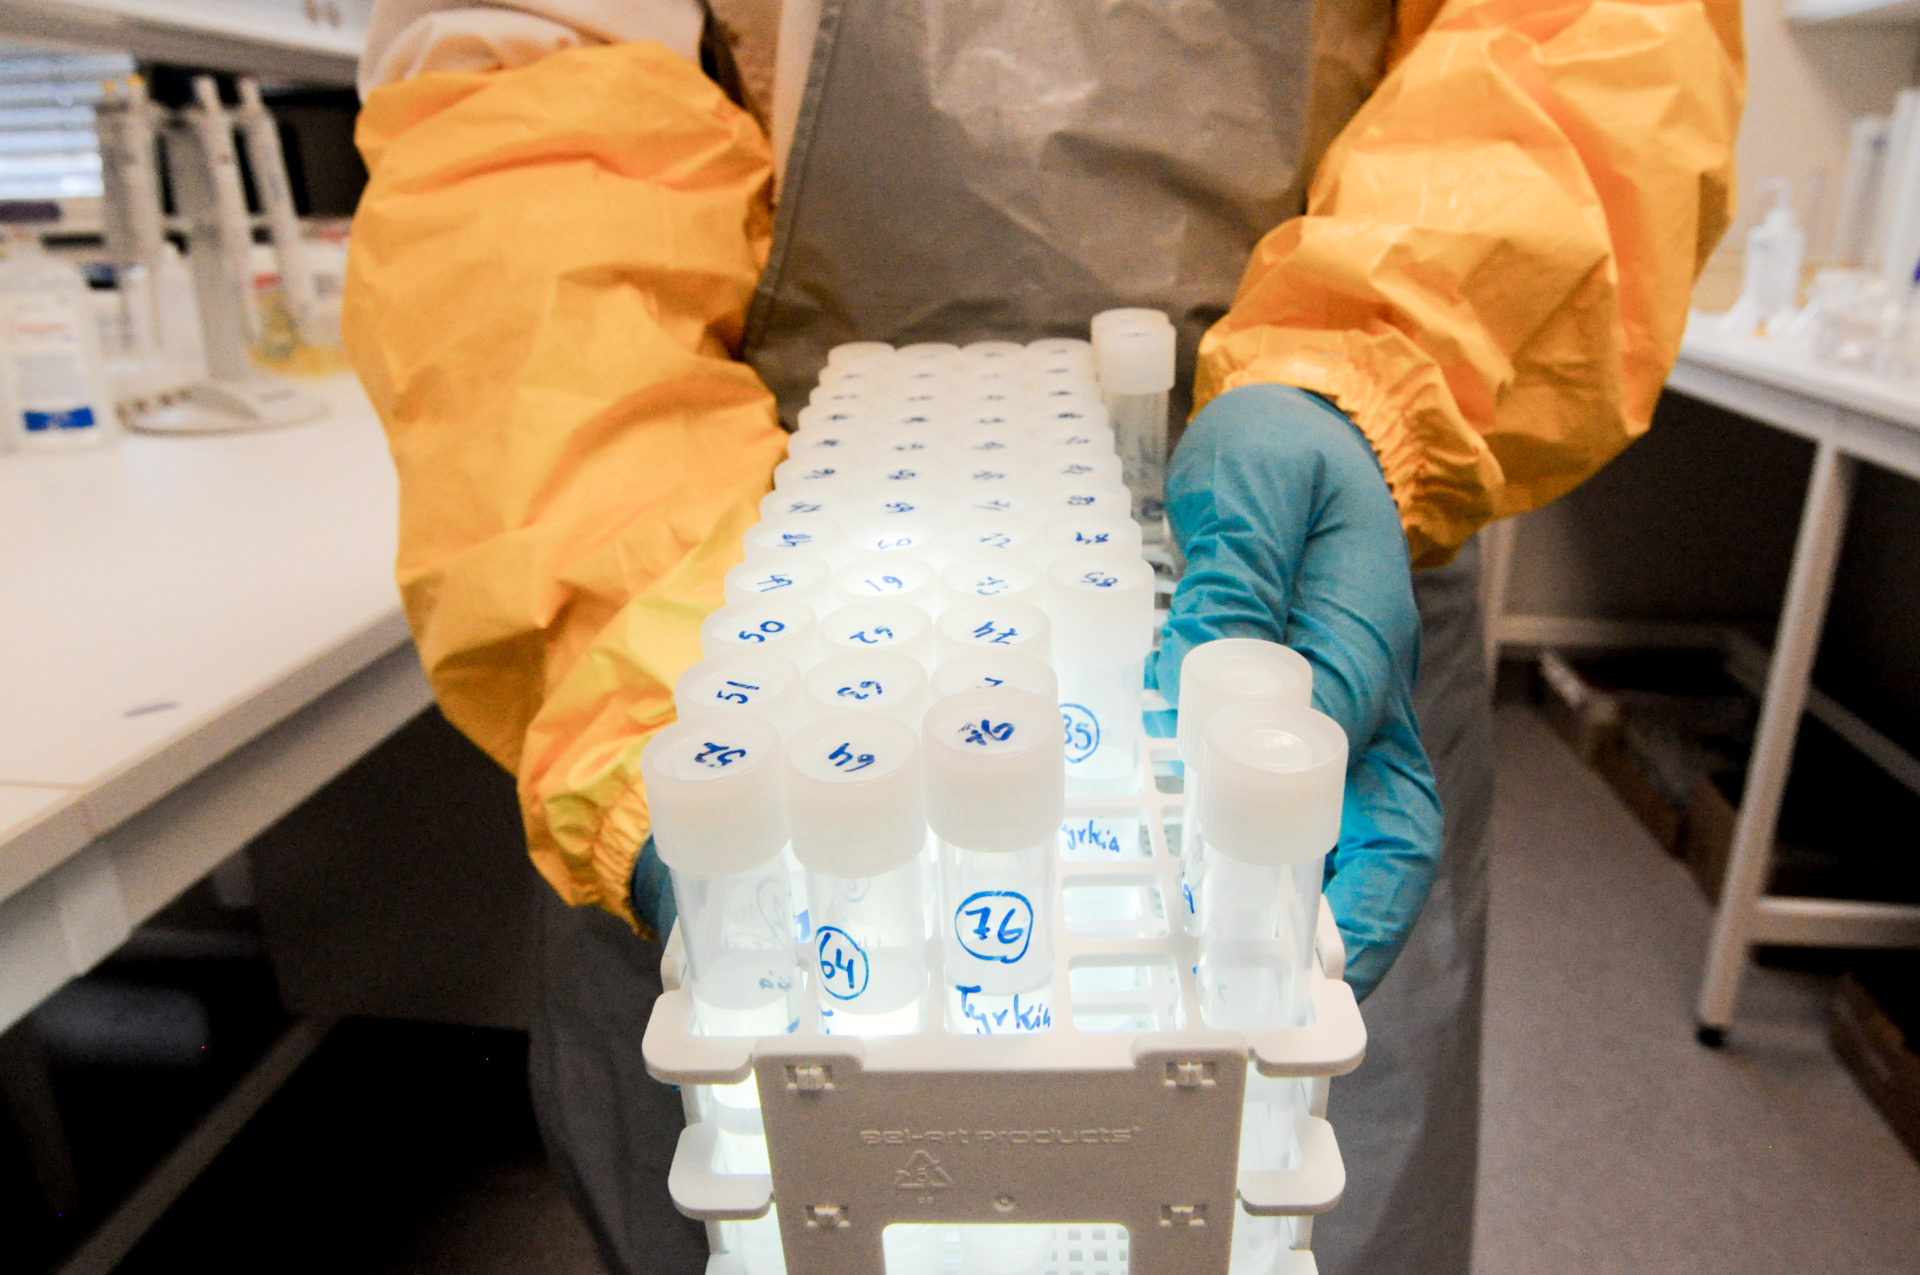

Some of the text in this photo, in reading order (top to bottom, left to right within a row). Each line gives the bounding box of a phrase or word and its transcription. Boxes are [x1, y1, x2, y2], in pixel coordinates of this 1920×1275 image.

[738, 620, 785, 644] 50
[716, 681, 760, 704] 51
[828, 742, 876, 772] 64
[964, 906, 1025, 944] 76
[818, 931, 854, 989] 64
